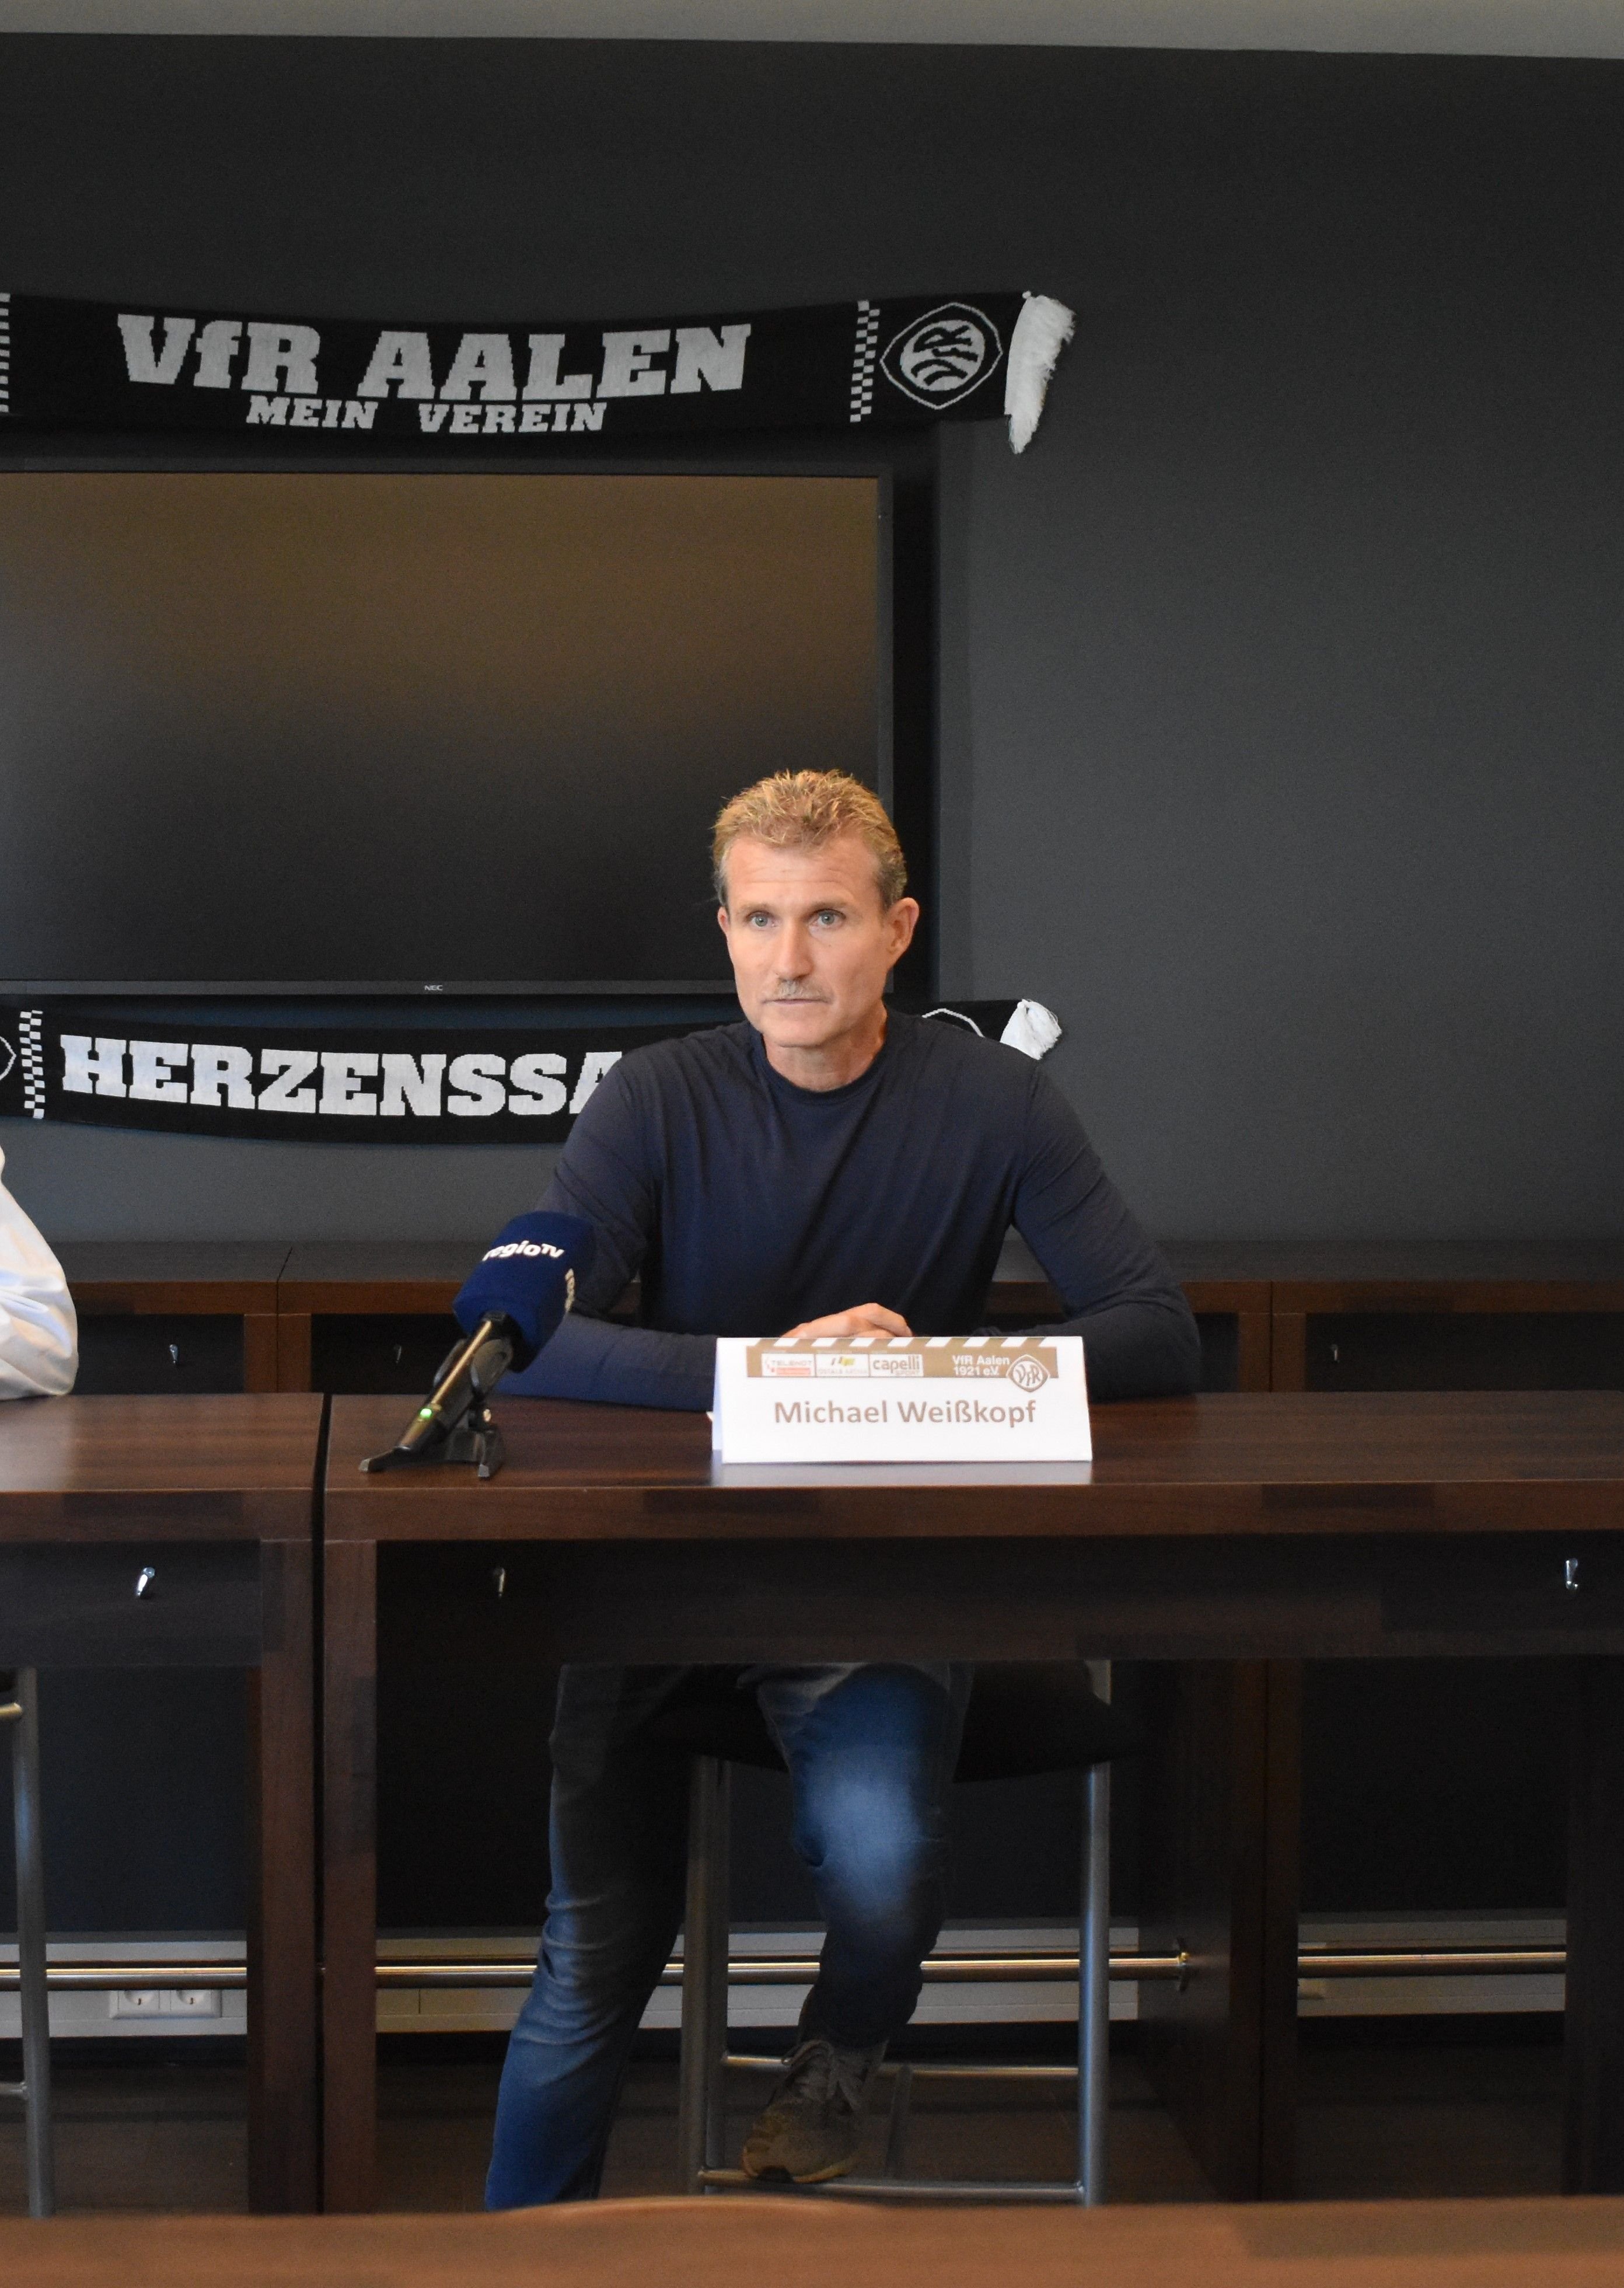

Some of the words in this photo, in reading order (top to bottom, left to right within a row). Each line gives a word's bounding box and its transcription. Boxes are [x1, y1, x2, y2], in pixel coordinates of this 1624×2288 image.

[118, 313, 321, 395] VfR
[357, 324, 752, 400] AALEN
[246, 395, 379, 429] MEIN
[418, 402, 607, 434] VEREIN
[873, 1355, 920, 1373] capelli
[952, 1355, 973, 1365] VfR
[977, 1355, 1010, 1365] Aalen
[954, 1366, 980, 1376] 1921
[774, 1400, 888, 1423] Michael
[897, 1400, 1036, 1428] Weißkopf
